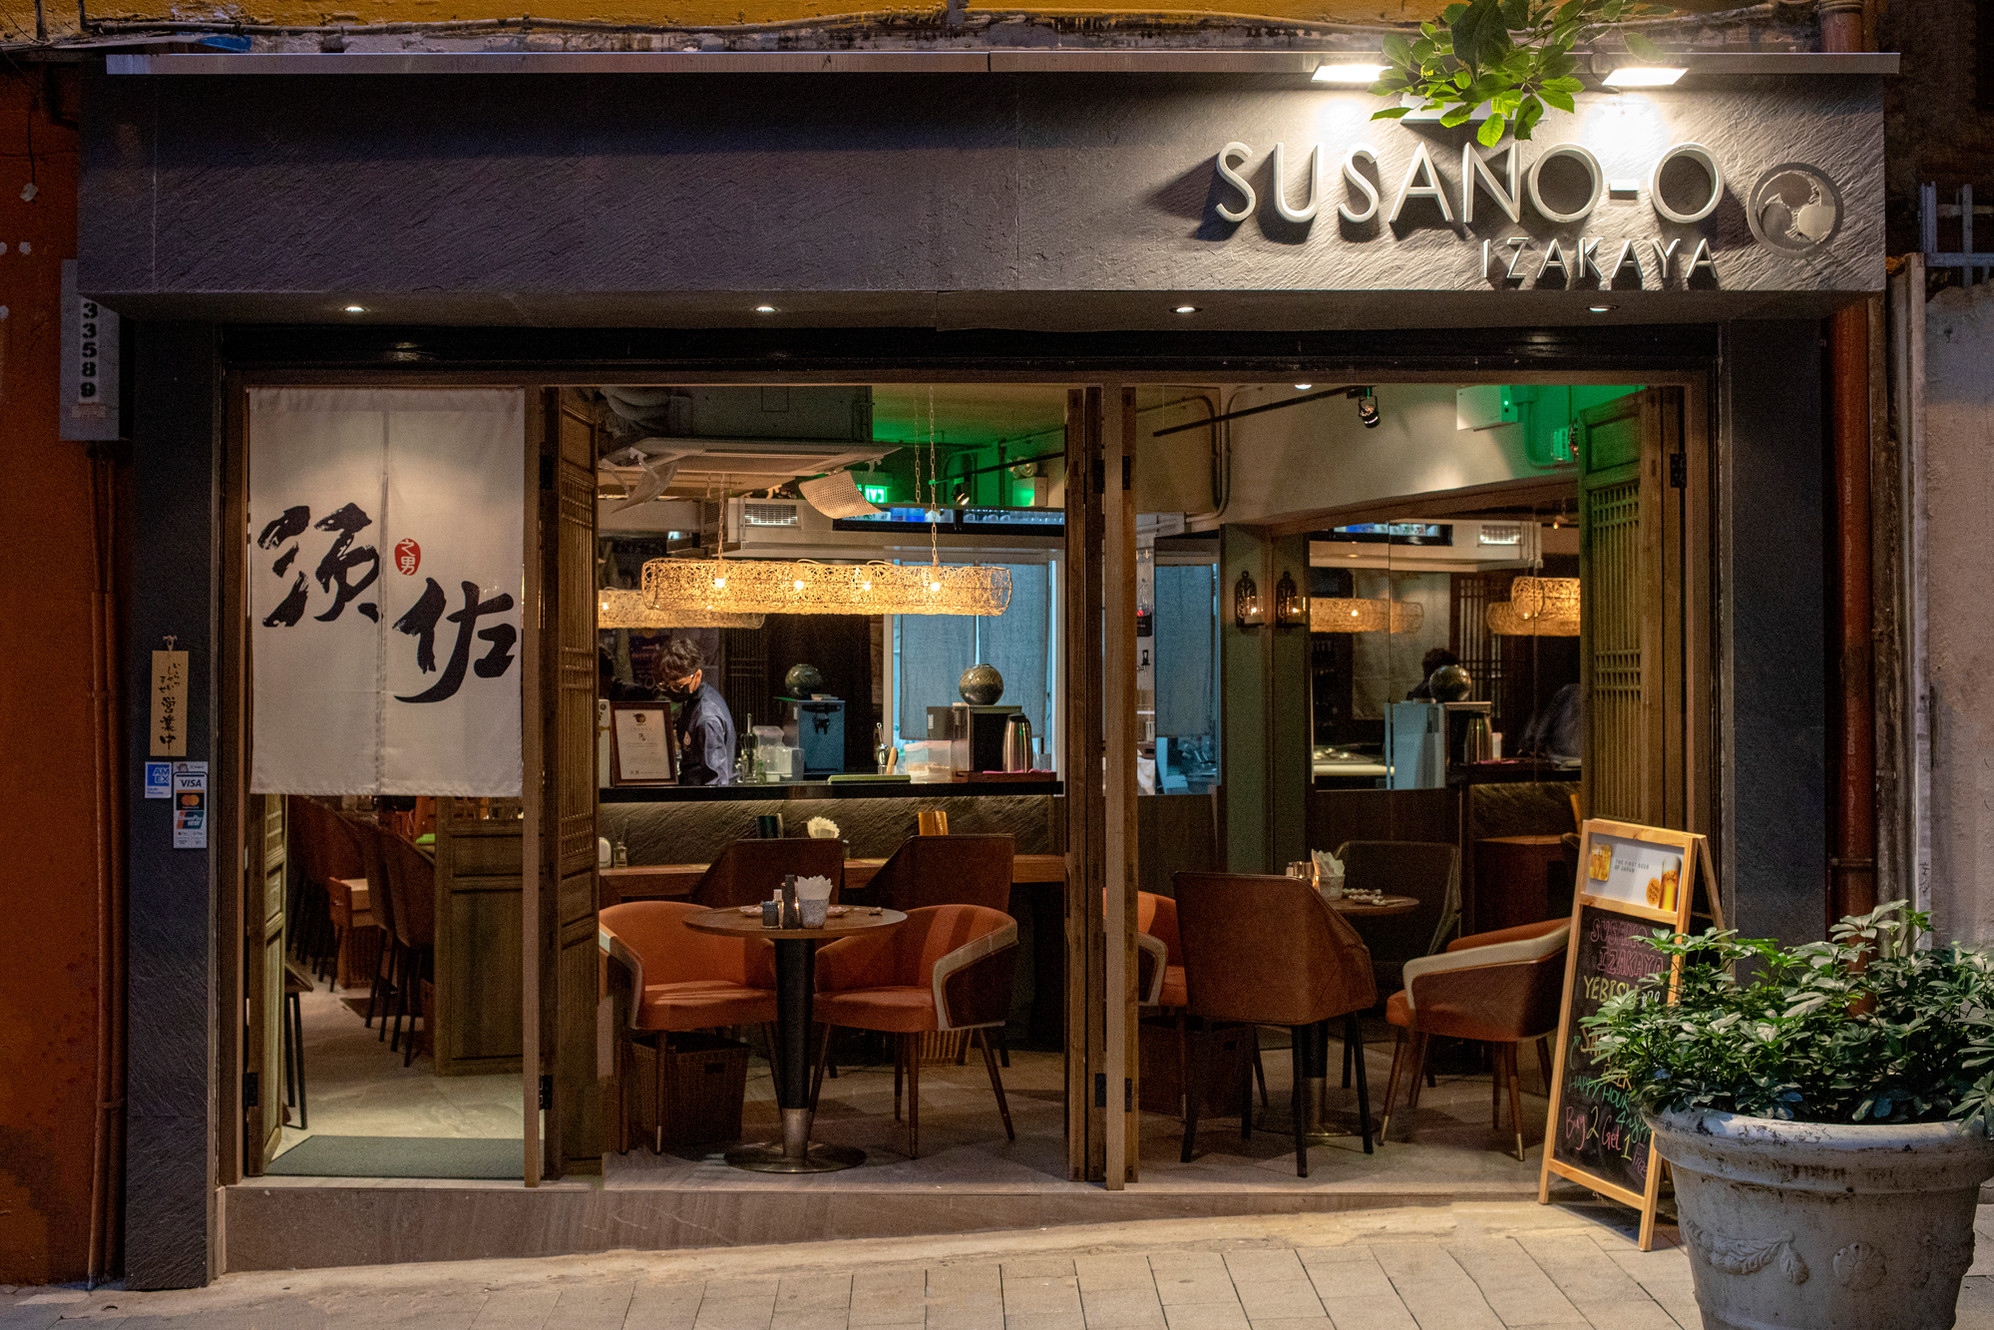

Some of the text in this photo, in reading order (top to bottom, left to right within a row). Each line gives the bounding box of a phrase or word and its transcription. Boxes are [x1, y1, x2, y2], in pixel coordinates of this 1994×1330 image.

[1214, 141, 1725, 224] SUSANO-O
[1482, 237, 1720, 280] IZAKAYA
[180, 779, 202, 787] VISA
[1620, 865, 1636, 873] JAPAN
[1624, 860, 1638, 868] FIRST
[1597, 946, 1664, 979] IZAKAYA
[1568, 1075, 1630, 1112] HAPPY HOUR
[1565, 1106, 1586, 1151] Buy
[1586, 1105, 1599, 1140] 2
[1601, 1115, 1622, 1151] Get
[1620, 1133, 1633, 1161] 1
